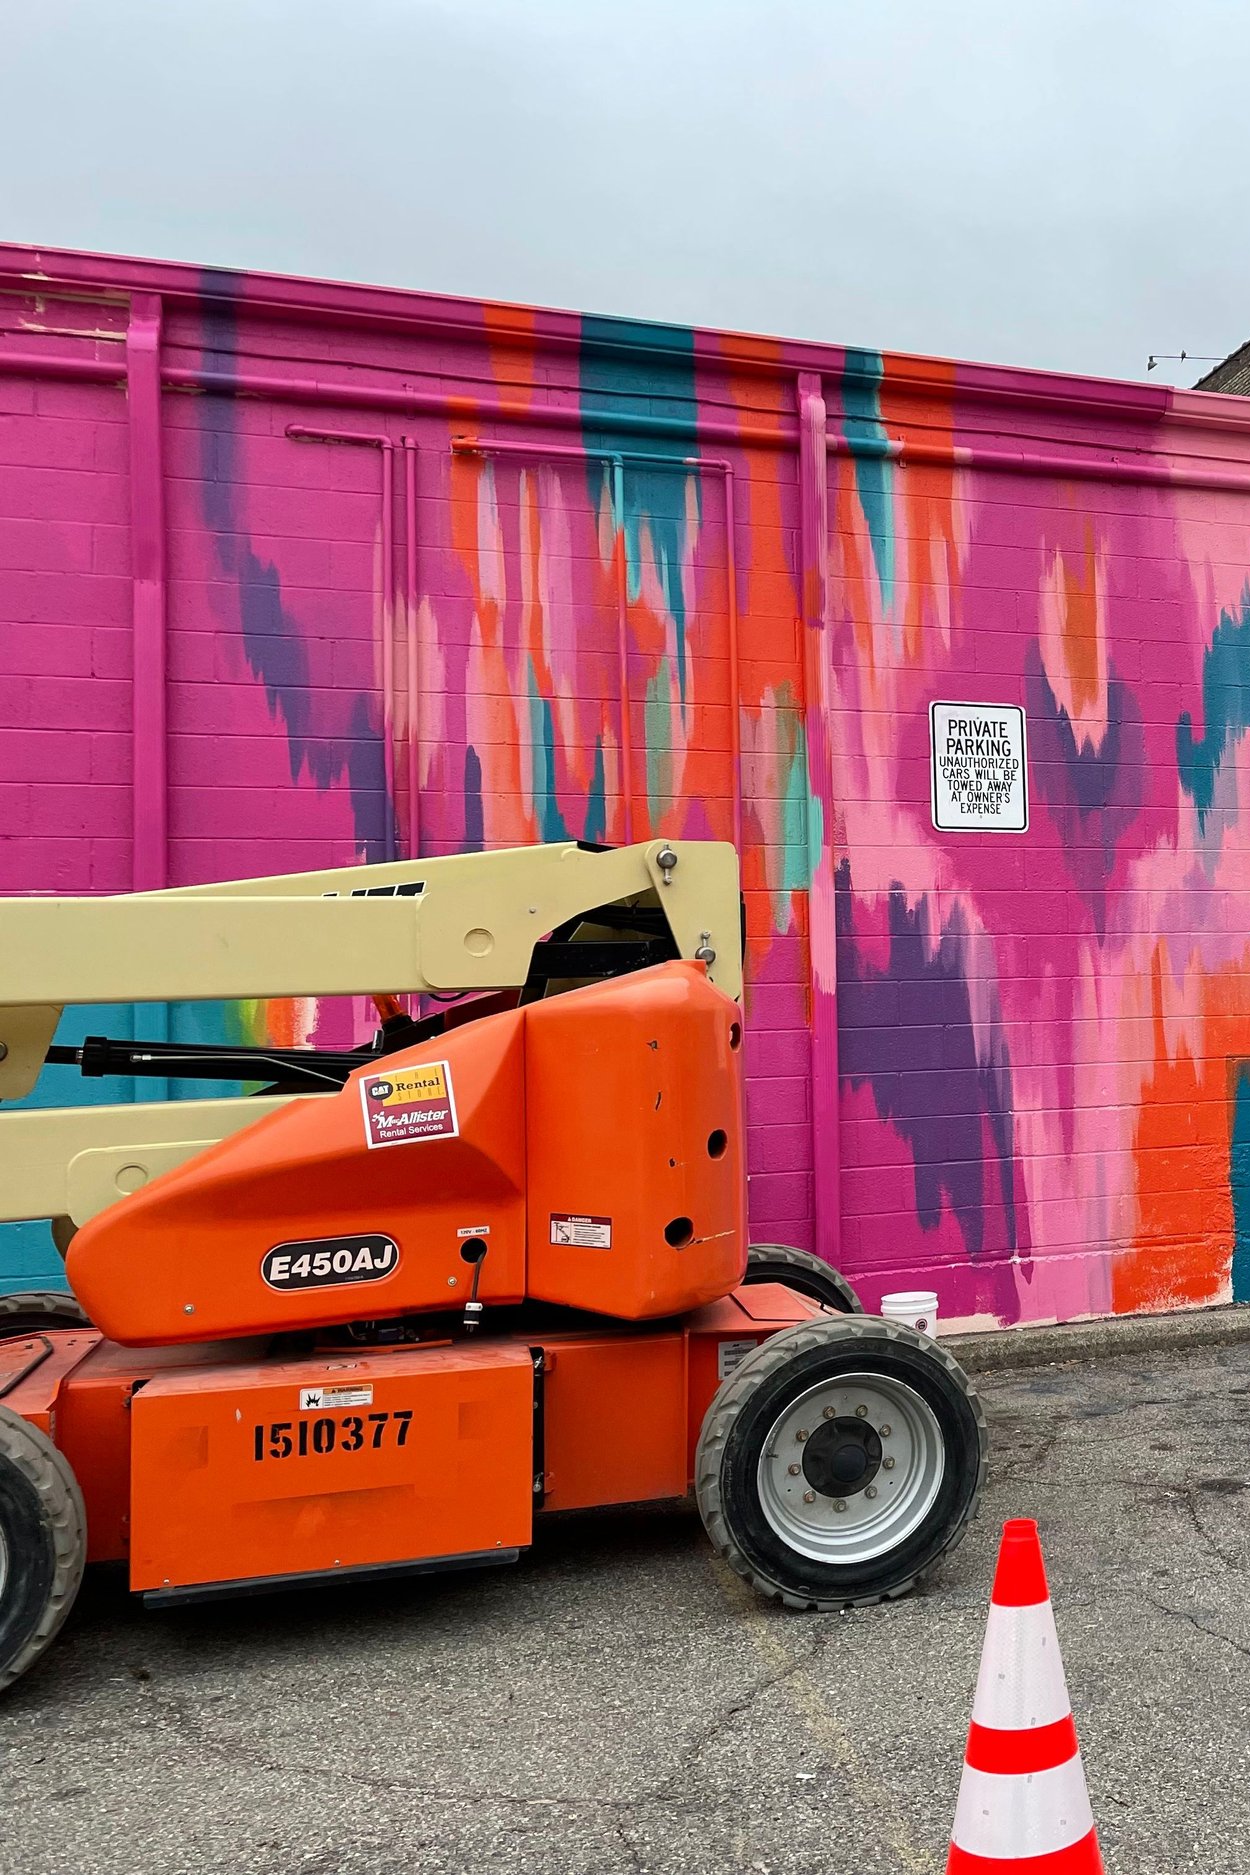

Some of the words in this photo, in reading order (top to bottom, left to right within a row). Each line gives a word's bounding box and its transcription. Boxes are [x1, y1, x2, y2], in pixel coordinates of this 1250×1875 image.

[948, 719, 1008, 738] PRIVATE
[946, 738, 1011, 757] PARKING
[939, 756, 1019, 769] UNAUTHORIZED
[942, 768, 970, 779] CARS
[975, 769, 999, 780] WILL
[1003, 770, 1017, 781] BE
[947, 780, 982, 791] TOWED
[987, 781, 1012, 792] AWAY
[951, 791, 962, 802] AT
[967, 792, 1010, 803] OWNER'S
[960, 803, 1001, 814] EXPENSE
[371, 1085, 389, 1096] CAT
[395, 1077, 440, 1091] Rental
[380, 1127, 407, 1138] Rental
[408, 1123, 443, 1134] Services
[269, 1244, 393, 1280] E450AJ
[254, 1410, 413, 1461] 1510377
